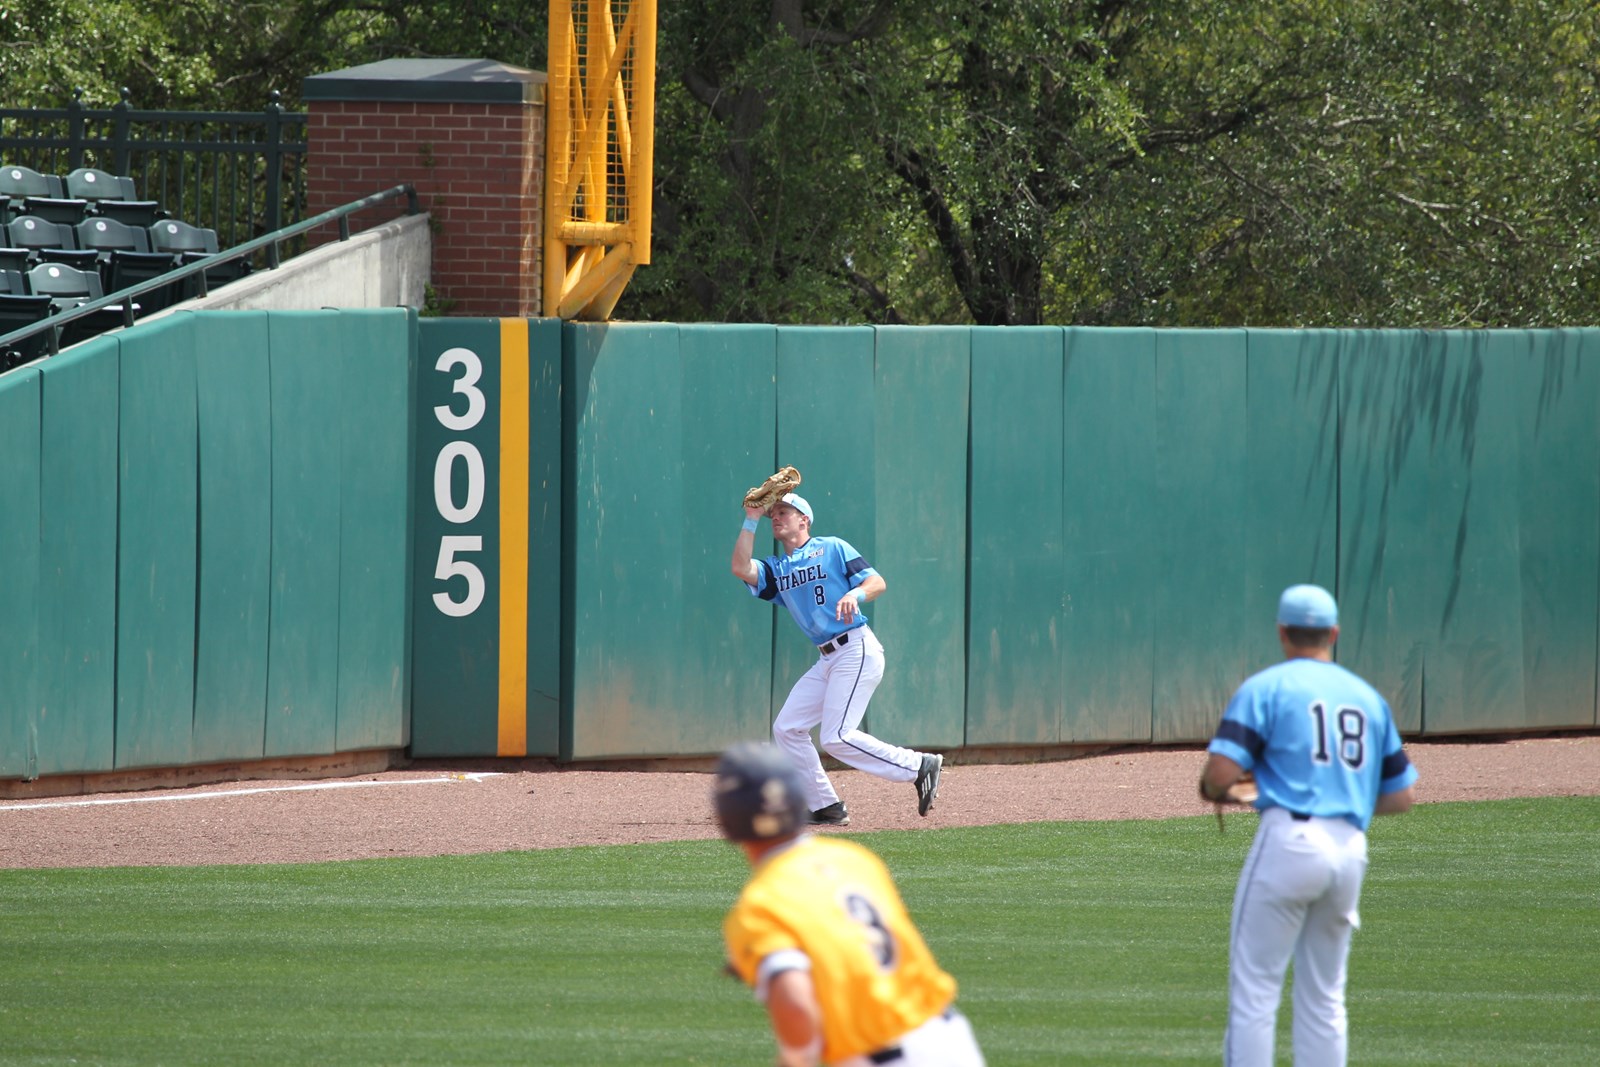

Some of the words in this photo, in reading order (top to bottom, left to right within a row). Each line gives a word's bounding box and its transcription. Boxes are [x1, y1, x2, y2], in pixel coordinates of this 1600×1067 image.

[432, 347, 486, 617] 305
[774, 564, 827, 592] ITADEL
[814, 584, 826, 606] 8
[1310, 702, 1364, 770] 18
[845, 892, 895, 969] 3
